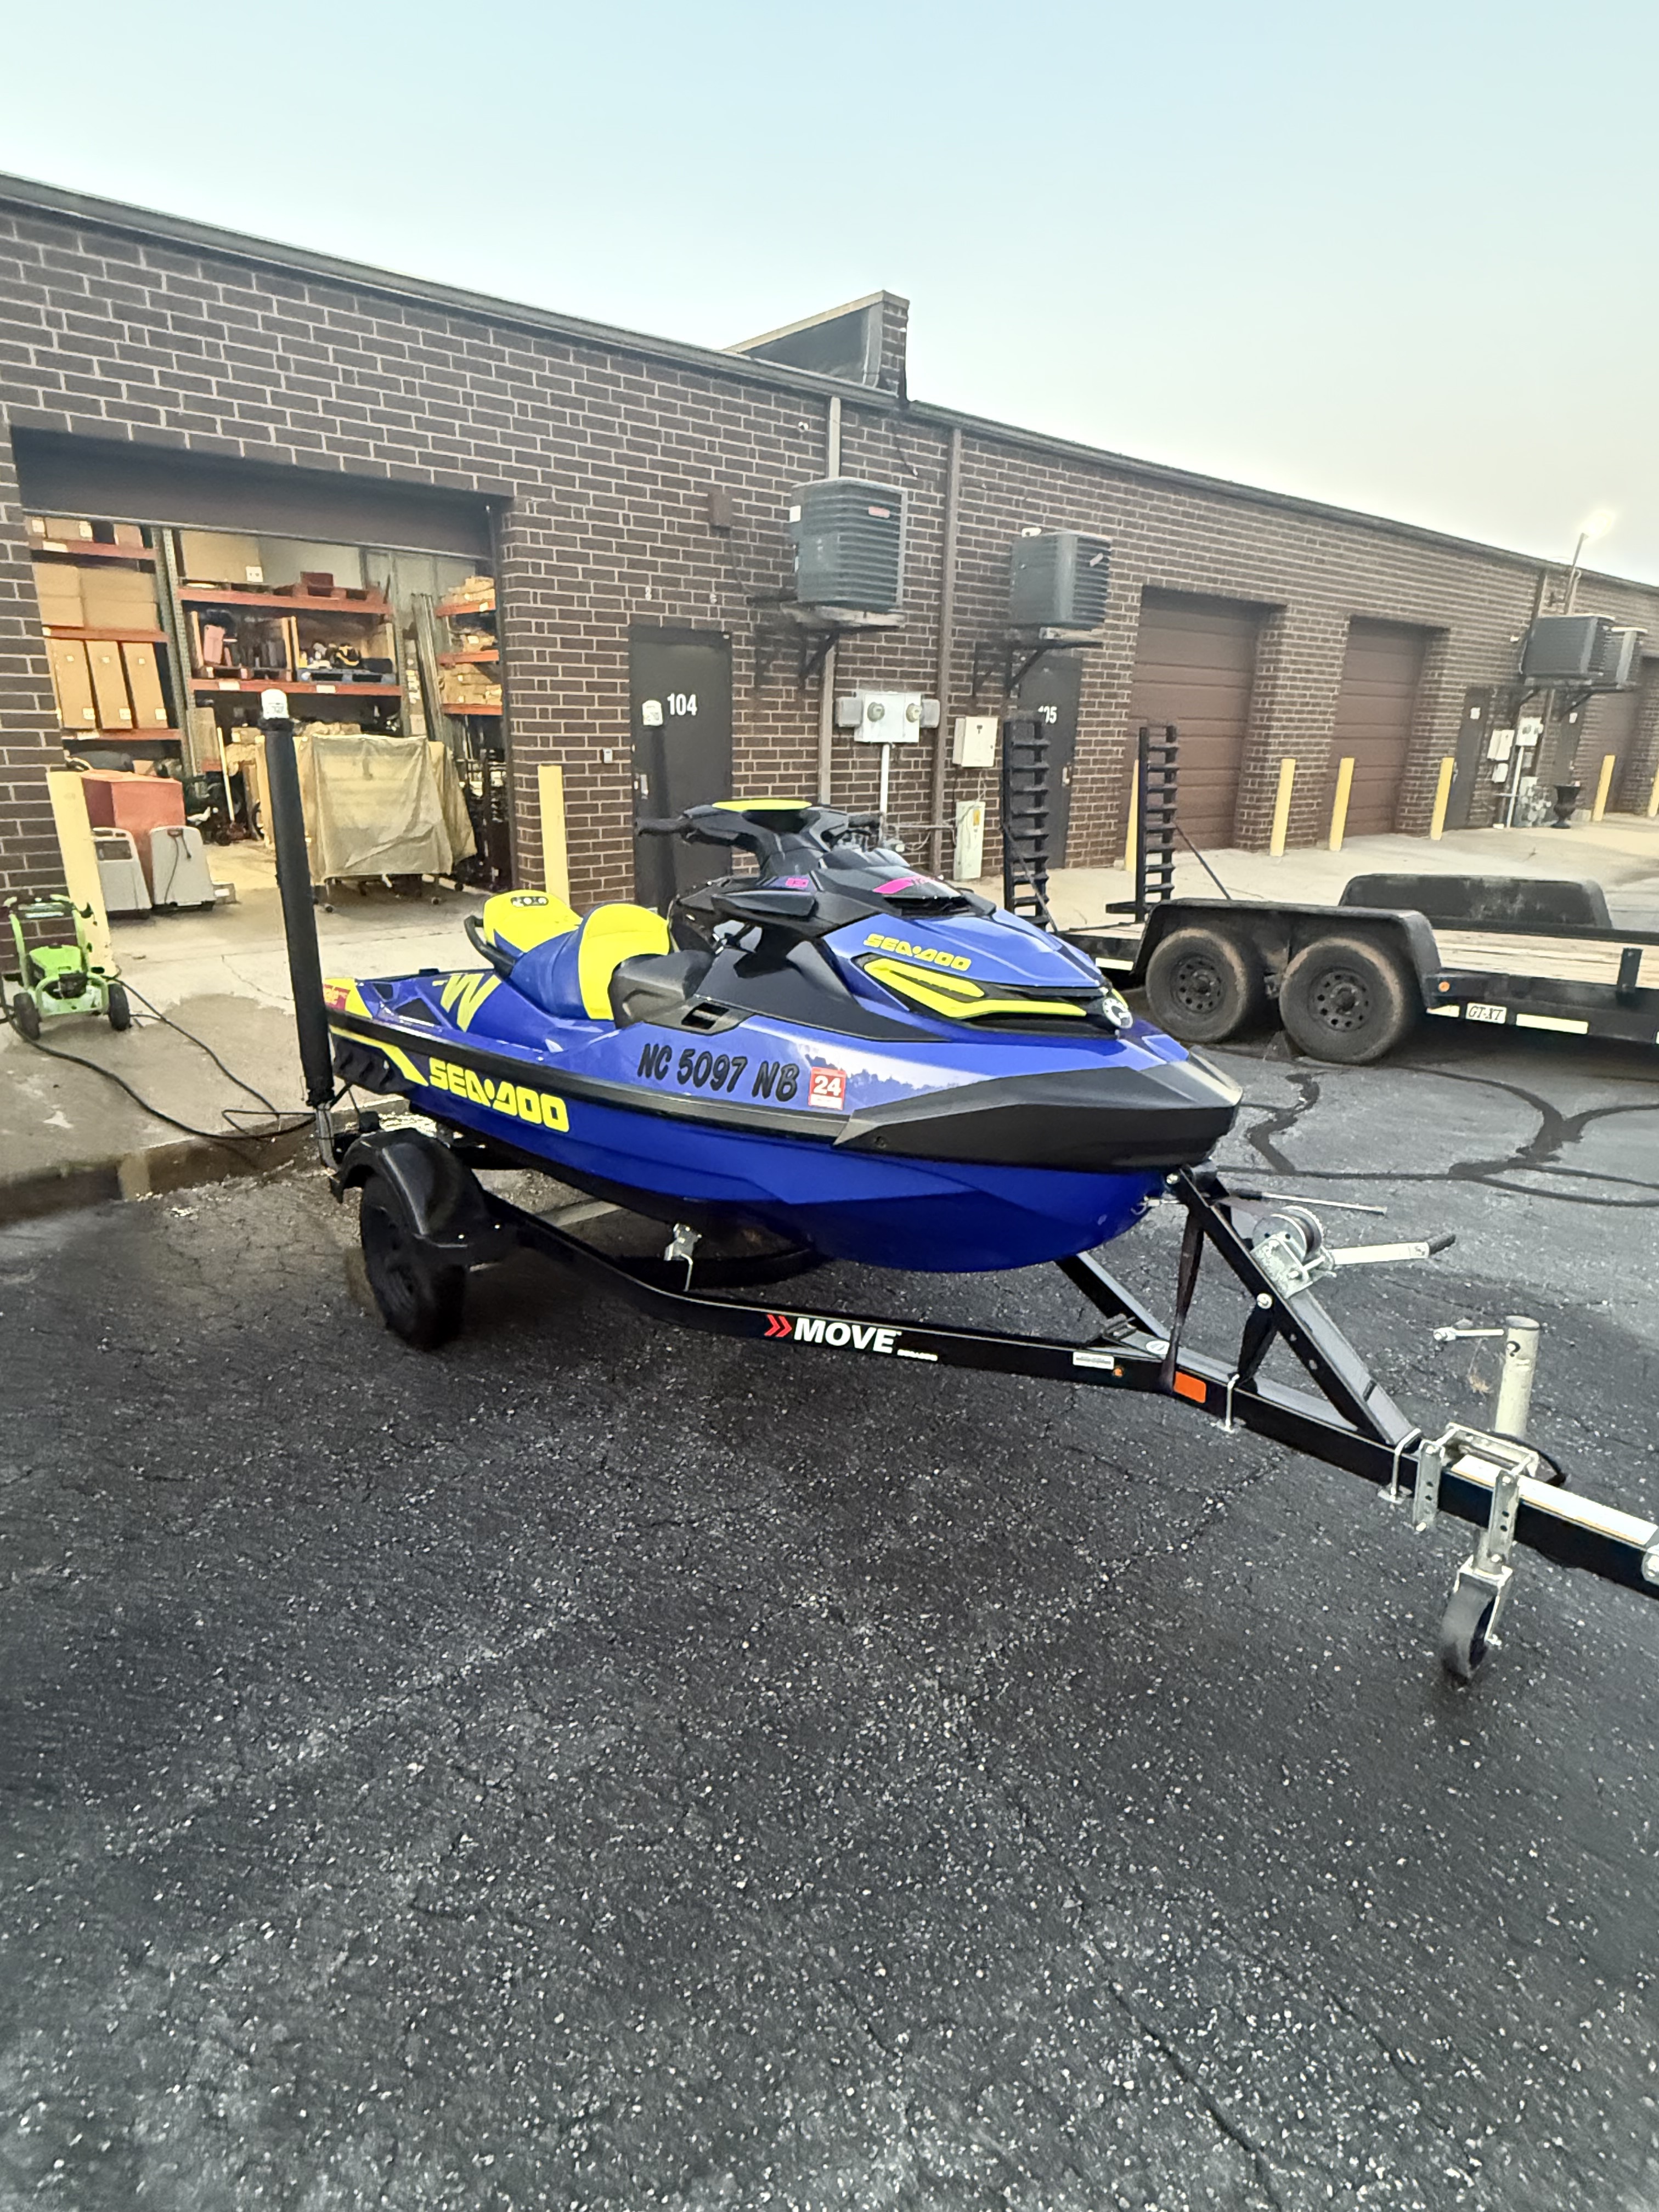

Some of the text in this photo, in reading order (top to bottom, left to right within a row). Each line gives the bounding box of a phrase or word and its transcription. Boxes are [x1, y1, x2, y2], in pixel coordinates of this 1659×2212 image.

[667, 693, 697, 716] 104
[637, 1043, 800, 1102] NC 5097 NB
[813, 1075, 842, 1096] 24
[793, 1317, 898, 1354] MOVE
